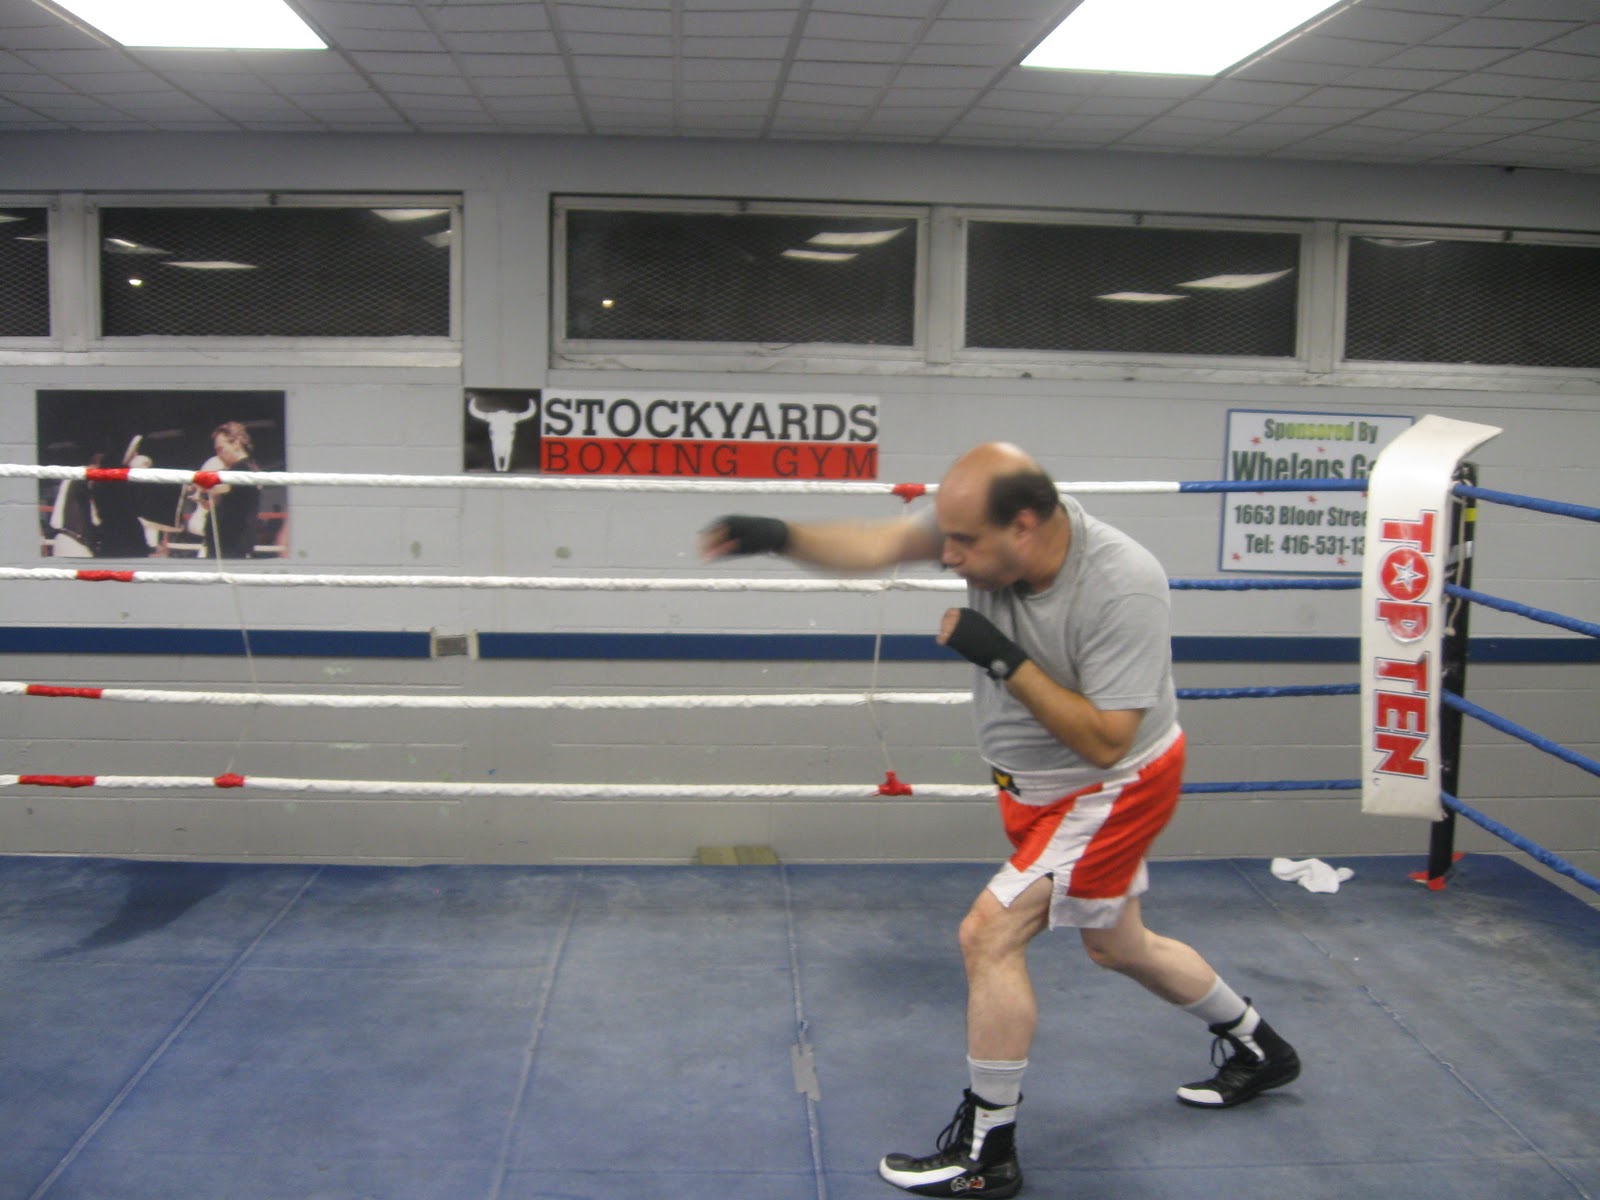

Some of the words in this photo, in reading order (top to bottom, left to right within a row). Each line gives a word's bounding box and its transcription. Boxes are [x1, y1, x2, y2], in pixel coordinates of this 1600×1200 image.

[544, 397, 878, 442] STOCKYARDS
[1264, 418, 1355, 442] Sponsored
[1358, 421, 1379, 444] By
[545, 441, 739, 476] BOXING
[772, 445, 878, 478] GYM
[1232, 451, 1344, 481] Whelans
[1350, 453, 1377, 481] G
[1234, 504, 1275, 525] 1663
[1279, 505, 1324, 526] Bloor
[1245, 533, 1274, 554] Tel:
[1376, 509, 1438, 644] TOP
[1373, 651, 1431, 780] TEN
